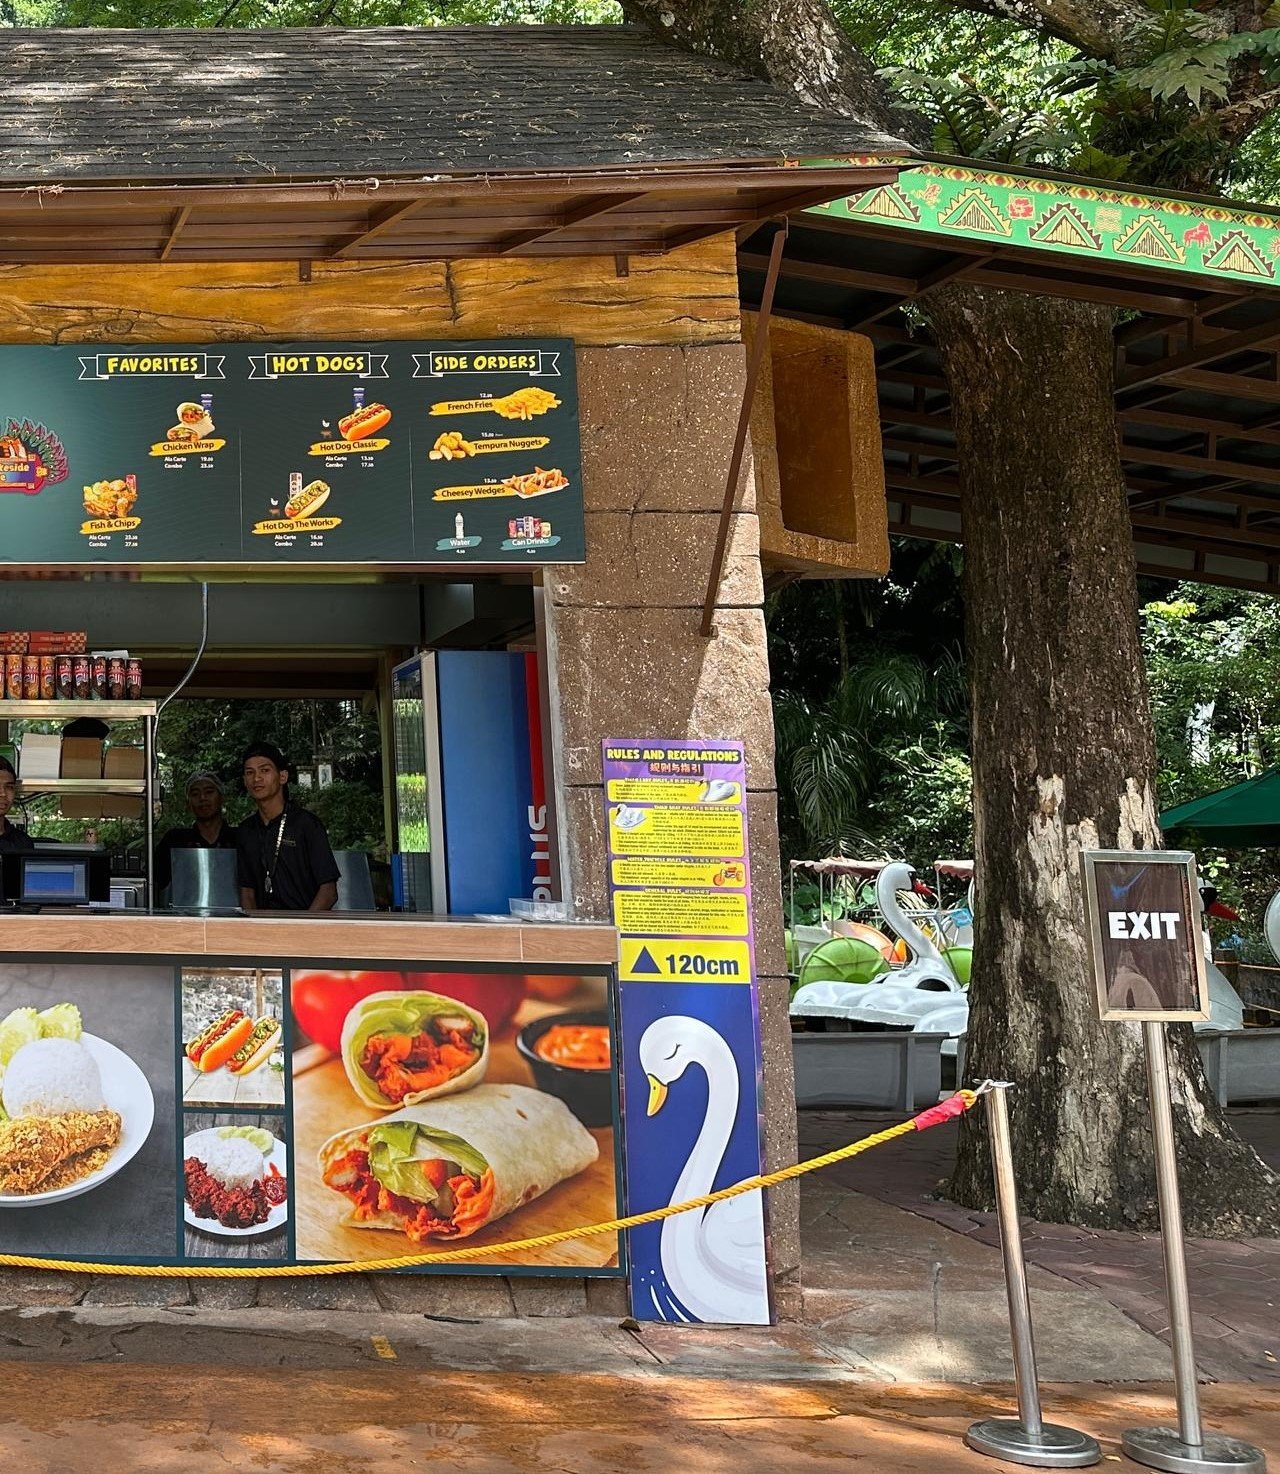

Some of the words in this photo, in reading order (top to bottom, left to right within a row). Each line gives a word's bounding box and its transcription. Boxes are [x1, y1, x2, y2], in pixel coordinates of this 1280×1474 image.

[107, 357, 198, 373] FAVORITES
[272, 356, 309, 372] HOT
[316, 355, 365, 372] DOGS
[434, 355, 468, 370] SIDE
[473, 354, 536, 370] ORDERS
[448, 403, 474, 411] French
[475, 401, 493, 409] Fries
[162, 443, 193, 451] Chicken
[193, 442, 214, 450] Wrap
[335, 443, 351, 451] Dog
[352, 441, 378, 449] Classic
[474, 442, 508, 451] Tempura
[509, 439, 542, 448] Nuggets
[442, 489, 474, 498] Cheesey
[474, 487, 506, 496] Wedges
[90, 521, 106, 529] Fish
[114, 520, 136, 528] Chips
[278, 522, 294, 530] Dog
[310, 519, 334, 527] Works
[527, 537, 550, 545] Drinks
[607, 749, 640, 760] RULES
[643, 749, 665, 760] AND
[667, 750, 739, 762] REGULATIONS
[1108, 911, 1181, 941] EXIT
[666, 954, 739, 975] 120cm
